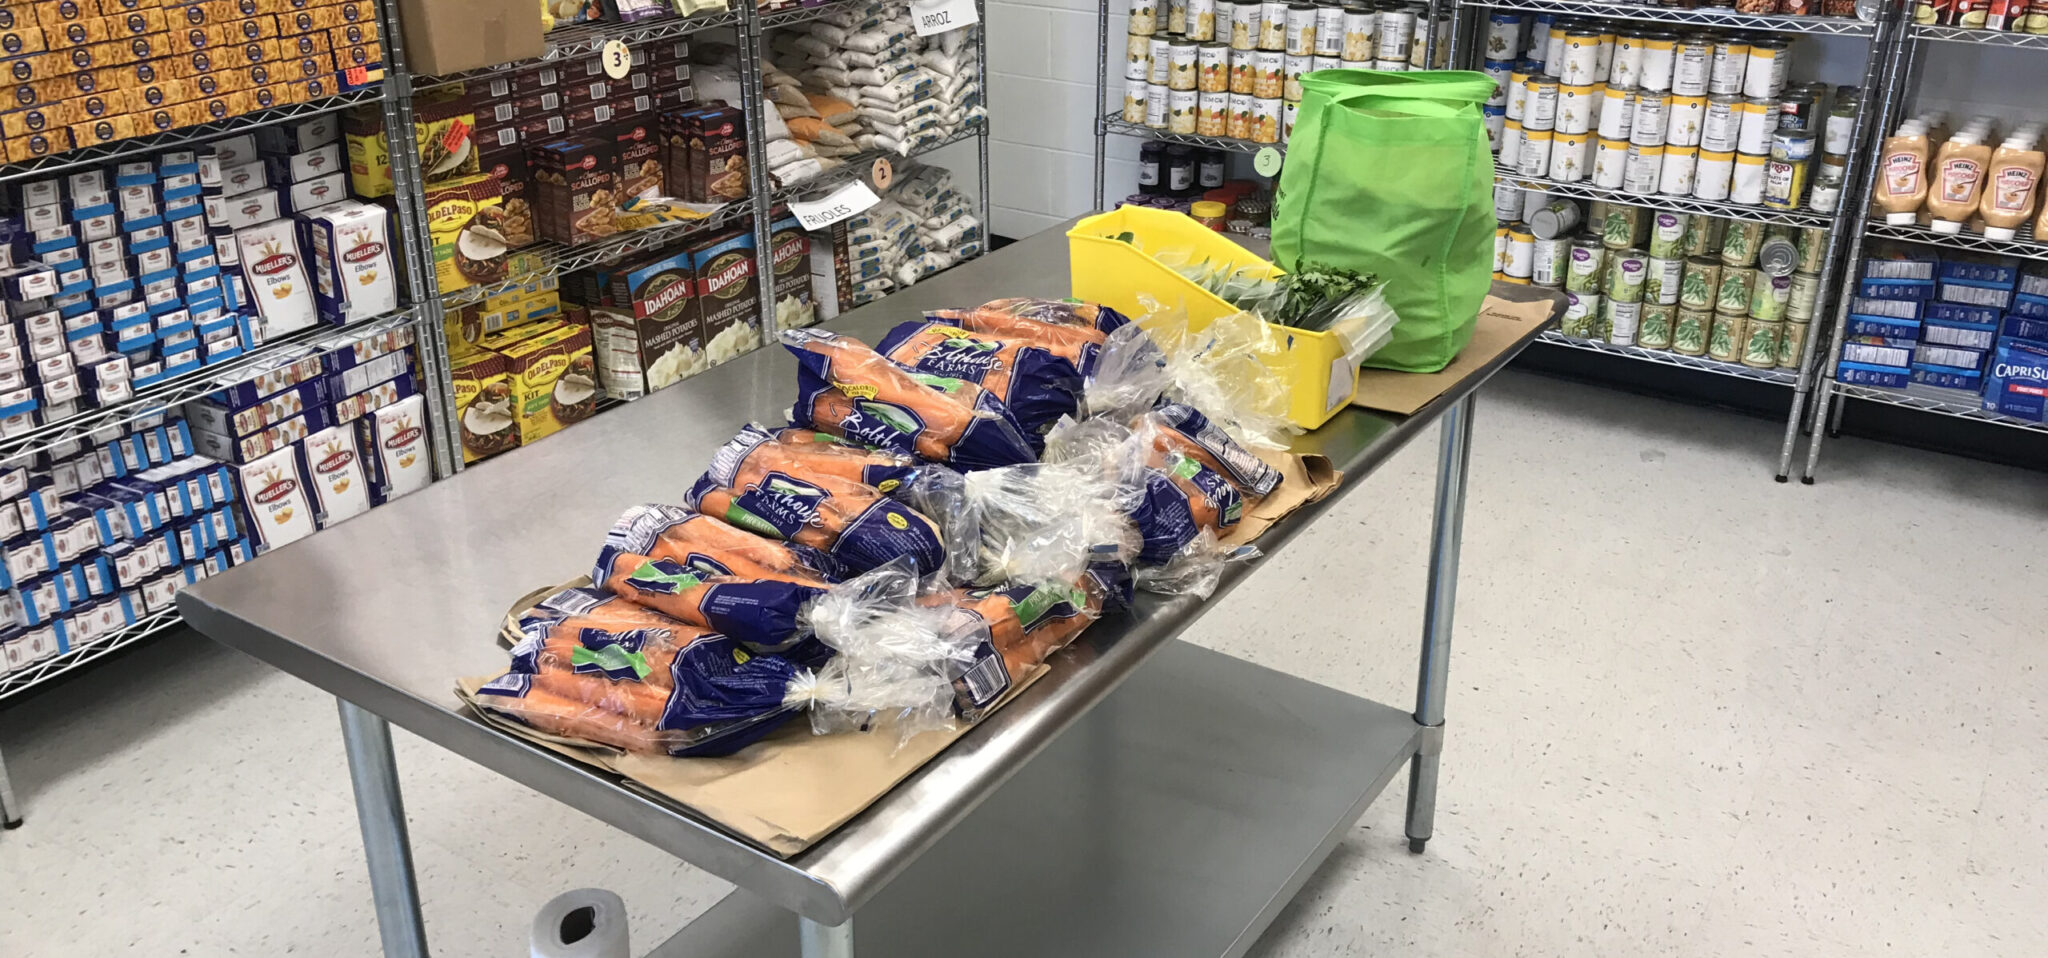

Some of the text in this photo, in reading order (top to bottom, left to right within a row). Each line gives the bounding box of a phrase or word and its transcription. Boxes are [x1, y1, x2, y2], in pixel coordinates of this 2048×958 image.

[921, 11, 951, 29] ARROZ
[613, 51, 622, 68] 3
[622, 144, 658, 160] SCALLOPED
[708, 141, 744, 155] SCALLOPED
[1263, 155, 1271, 166] 3
[1954, 163, 1974, 171] HEINZ
[878, 167, 887, 180] 2
[500, 182, 524, 196] LOPED
[571, 174, 610, 191] SCALLOPED
[803, 204, 852, 226] FRIJOLES
[345, 244, 380, 261] MUELLER'S
[773, 239, 803, 264] AHOAN
[254, 255, 293, 273] MUELLER'S
[354, 262, 377, 273] Elbows
[266, 274, 291, 286] Elbows
[708, 261, 749, 293] IDAHOAN
[644, 281, 687, 316] IDAHOAN
[706, 308, 733, 324] MASHED
[732, 297, 757, 314] POTATOES
[645, 330, 672, 348] MASHED
[671, 318, 698, 336] POTATOES
[527, 366, 541, 380] OLD
[541, 361, 550, 371] EL
[927, 358, 977, 375] FARMS
[1995, 363, 2032, 378] CAPRI
[524, 390, 540, 401] KIT
[1986, 402, 1996, 410] 10
[387, 428, 419, 447] MUELLER'S
[395, 446, 416, 458] Elbows
[319, 452, 351, 472] MUELLER'S
[328, 470, 349, 482] Elbows
[257, 481, 293, 502] MUELLER'S
[268, 499, 291, 512] Elbows
